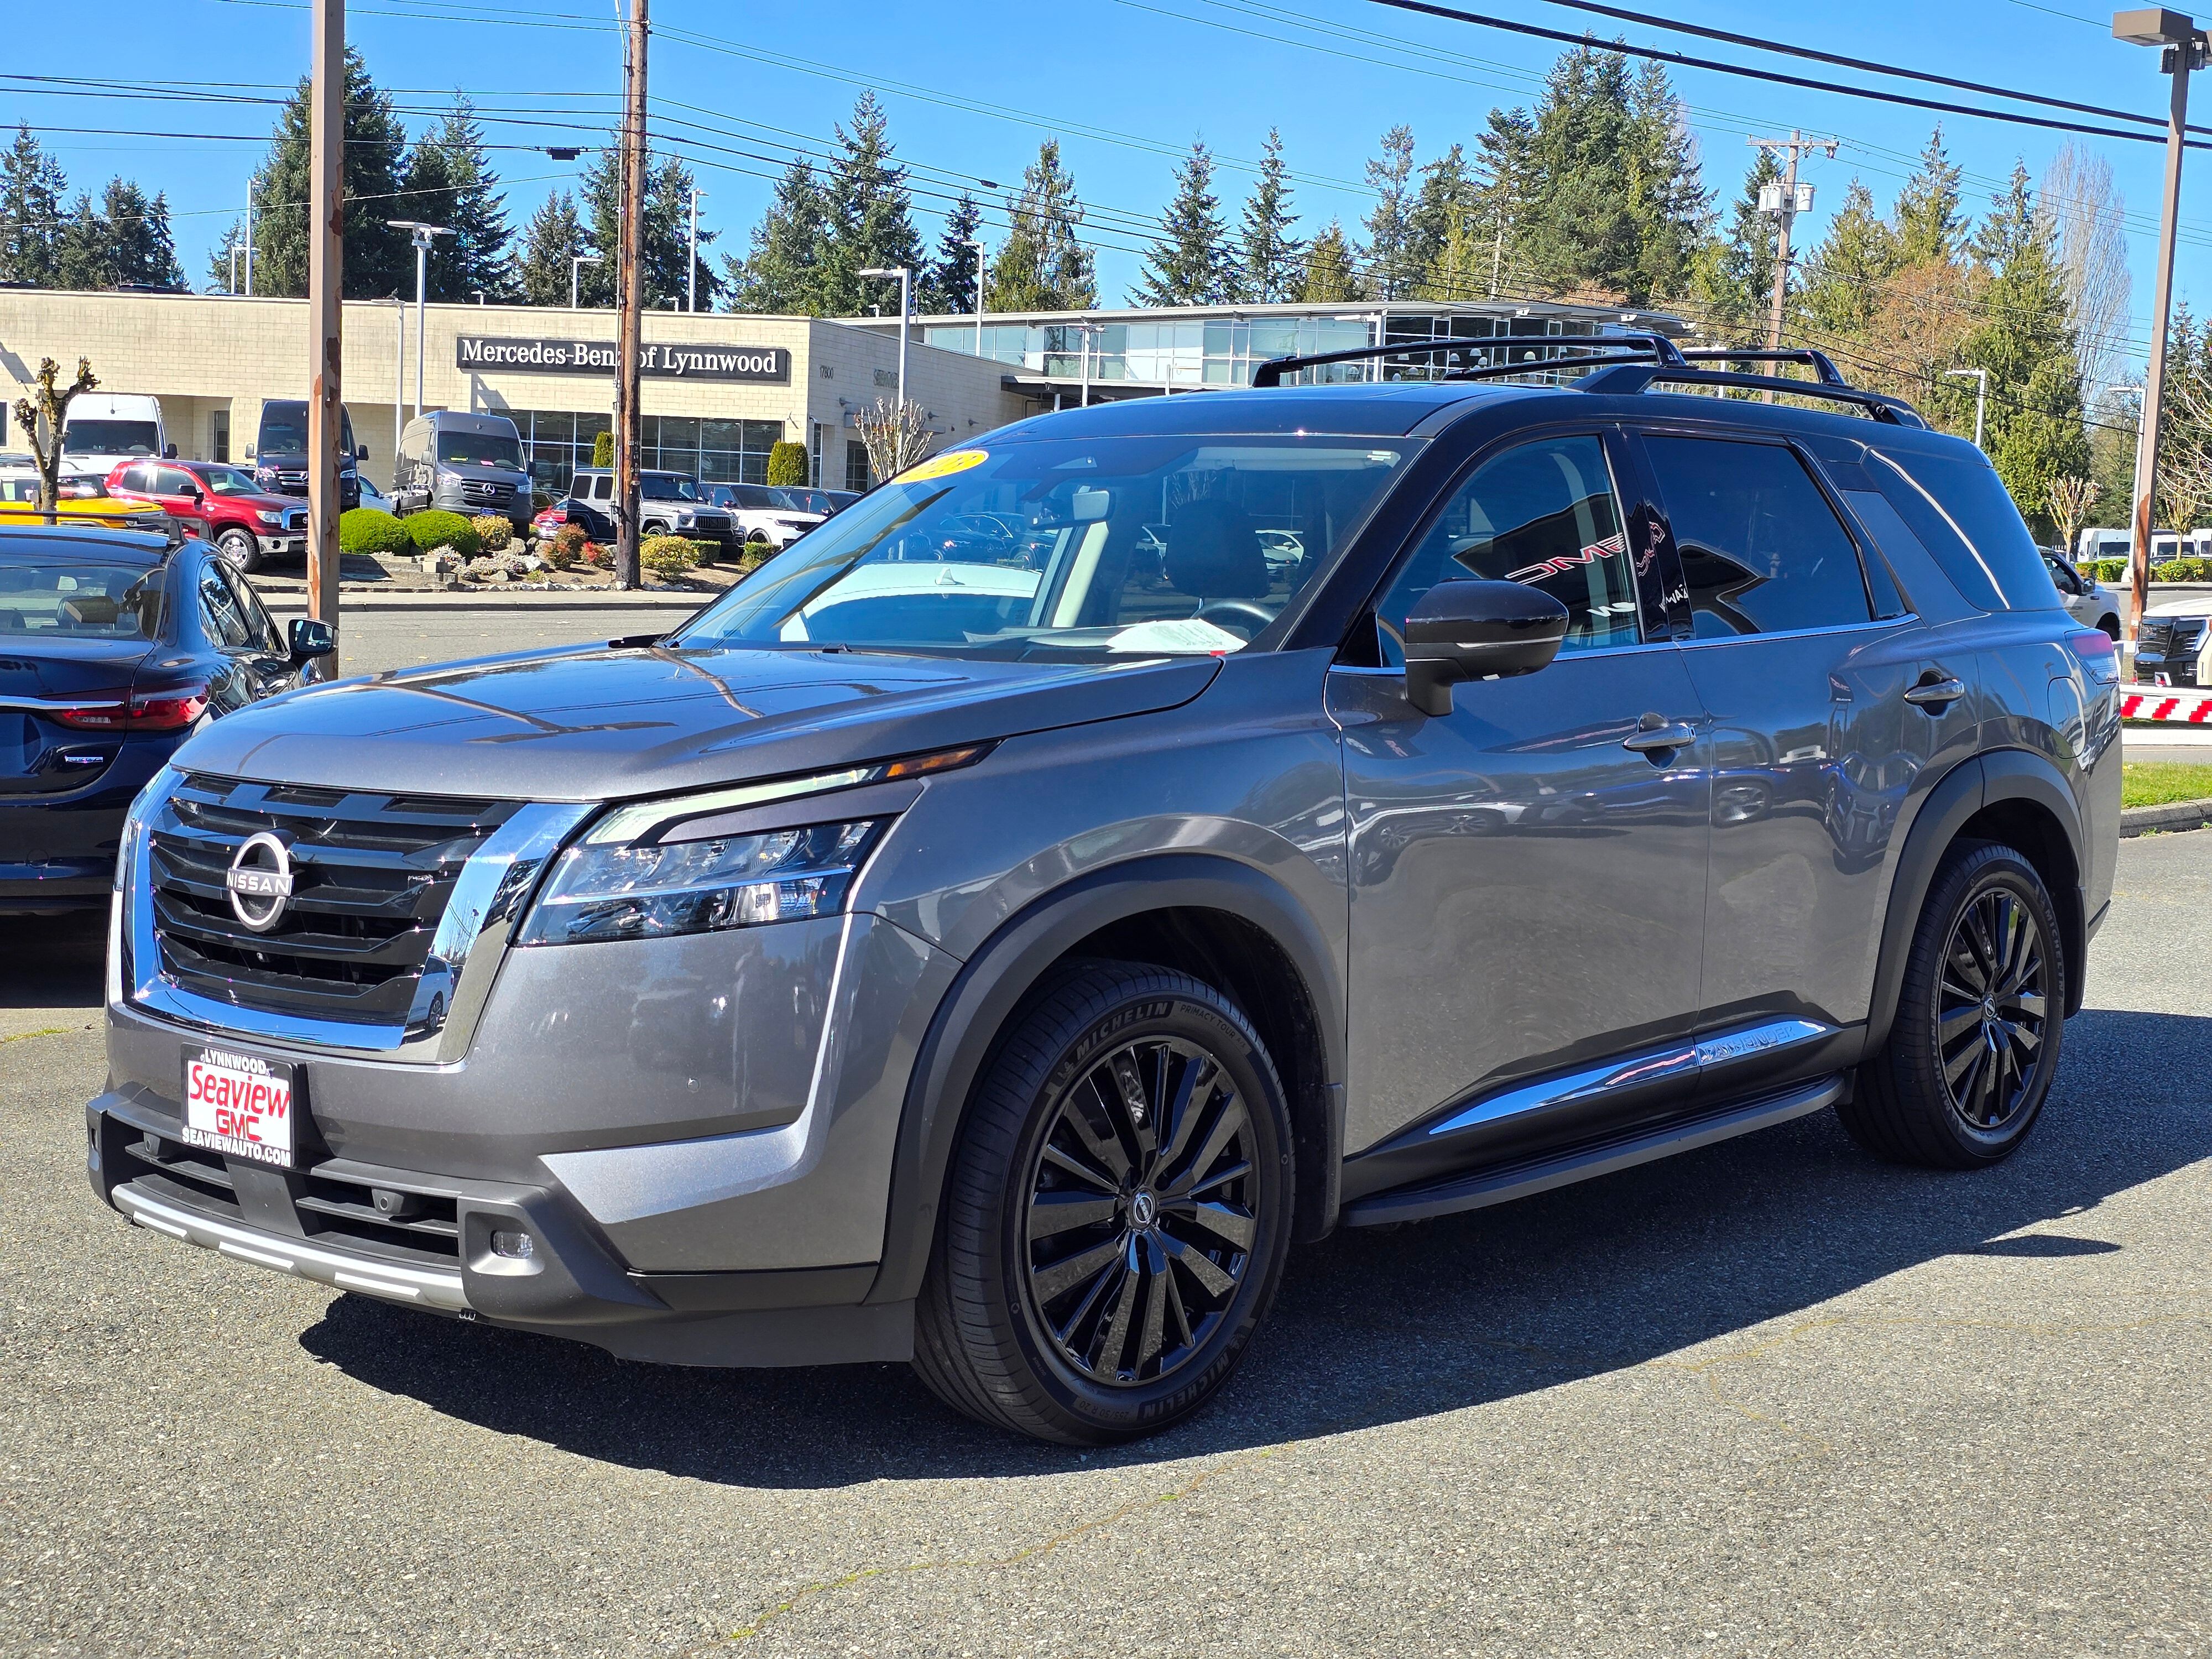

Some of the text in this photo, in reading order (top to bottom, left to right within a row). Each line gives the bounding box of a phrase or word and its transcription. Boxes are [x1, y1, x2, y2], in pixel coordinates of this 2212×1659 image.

[461, 339, 621, 366] Mercedes-Ben
[662, 347, 777, 374] Lynnwood
[226, 872, 290, 894] NISSAN
[2046, 909, 2063, 991] MICHELIN
[1076, 1001, 1168, 1061] MICHELIN
[1180, 1004, 1215, 1022] PRIMACY
[1217, 1019, 1236, 1039] TOUR
[1705, 1026, 1795, 1057] PATHFINDER
[205, 1048, 267, 1075] LYNNWOOD
[190, 1065, 290, 1118] Seaview
[216, 1108, 263, 1142] GMC
[182, 1126, 291, 1167] SEAVIEWAUTO.COM
[1144, 1352, 1229, 1419] MICHELIN
[1078, 1400, 1091, 1411] 20
[1099, 1408, 1130, 1420] 255/50
